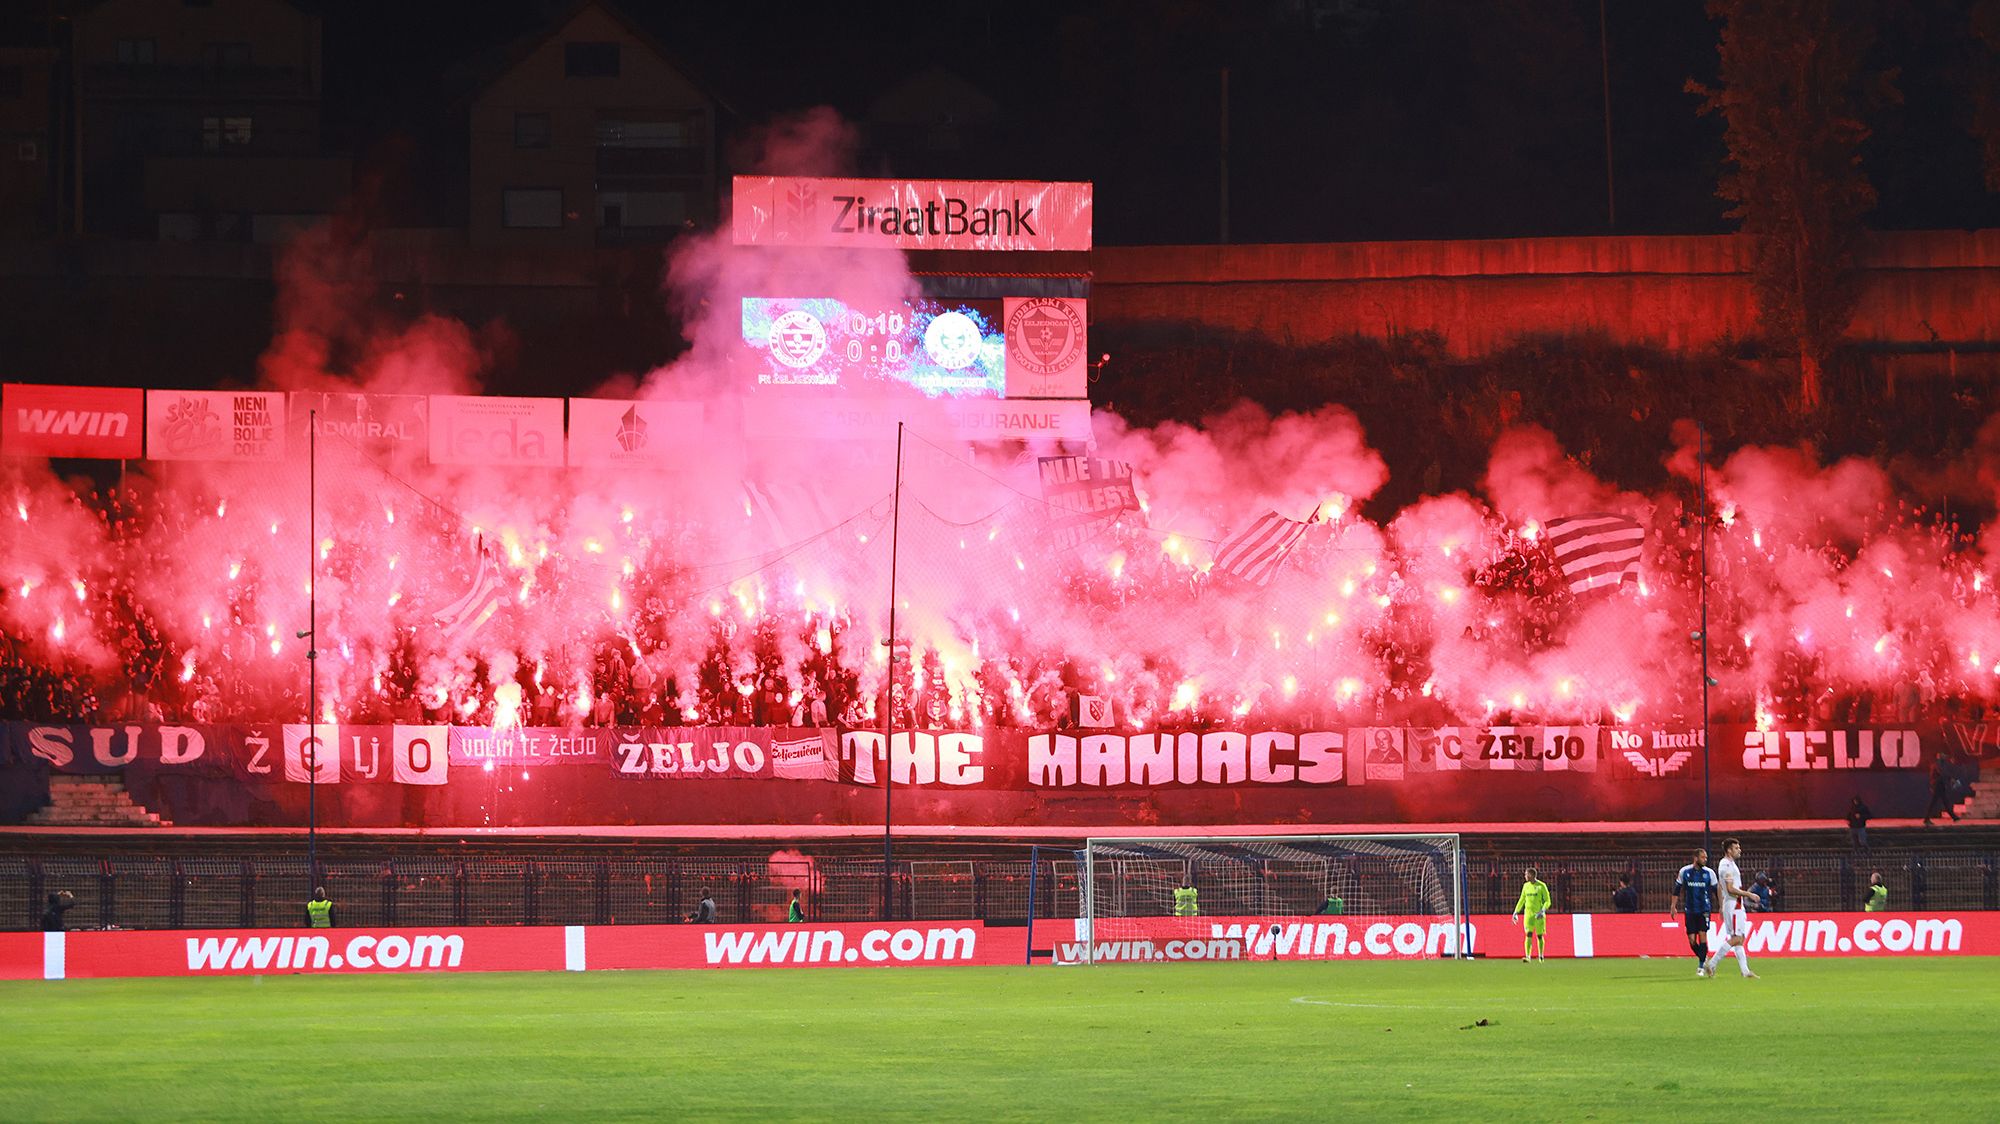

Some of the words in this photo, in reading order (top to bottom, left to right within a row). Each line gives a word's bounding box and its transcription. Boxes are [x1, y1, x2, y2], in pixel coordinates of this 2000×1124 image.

[832, 197, 1036, 237] ZiraatBank
[1009, 297, 1061, 333] FUDBALSKI
[1062, 305, 1083, 335] KLUB
[233, 396, 267, 411] MENI
[233, 411, 273, 426] NEMA
[303, 418, 414, 440] ADMIRAL
[446, 416, 545, 459] leda
[1040, 456, 1091, 486] NIJE
[28, 725, 206, 768] SUD
[461, 738, 514, 758] VOLIM
[548, 734, 597, 757] ŽELJO
[617, 732, 765, 774] ŽELJO
[1421, 735, 1464, 763] FC
[1477, 729, 1585, 761] ŽELJO
[1611, 730, 1643, 749] No
[1652, 728, 1705, 749] limit
[842, 731, 984, 785] THE
[1028, 731, 1344, 787] MANIACS
[186, 933, 465, 970] wwin.com
[704, 927, 977, 964] wwin.com
[1062, 940, 1240, 961] wwin.com
[1211, 921, 1477, 956] wwin.com
